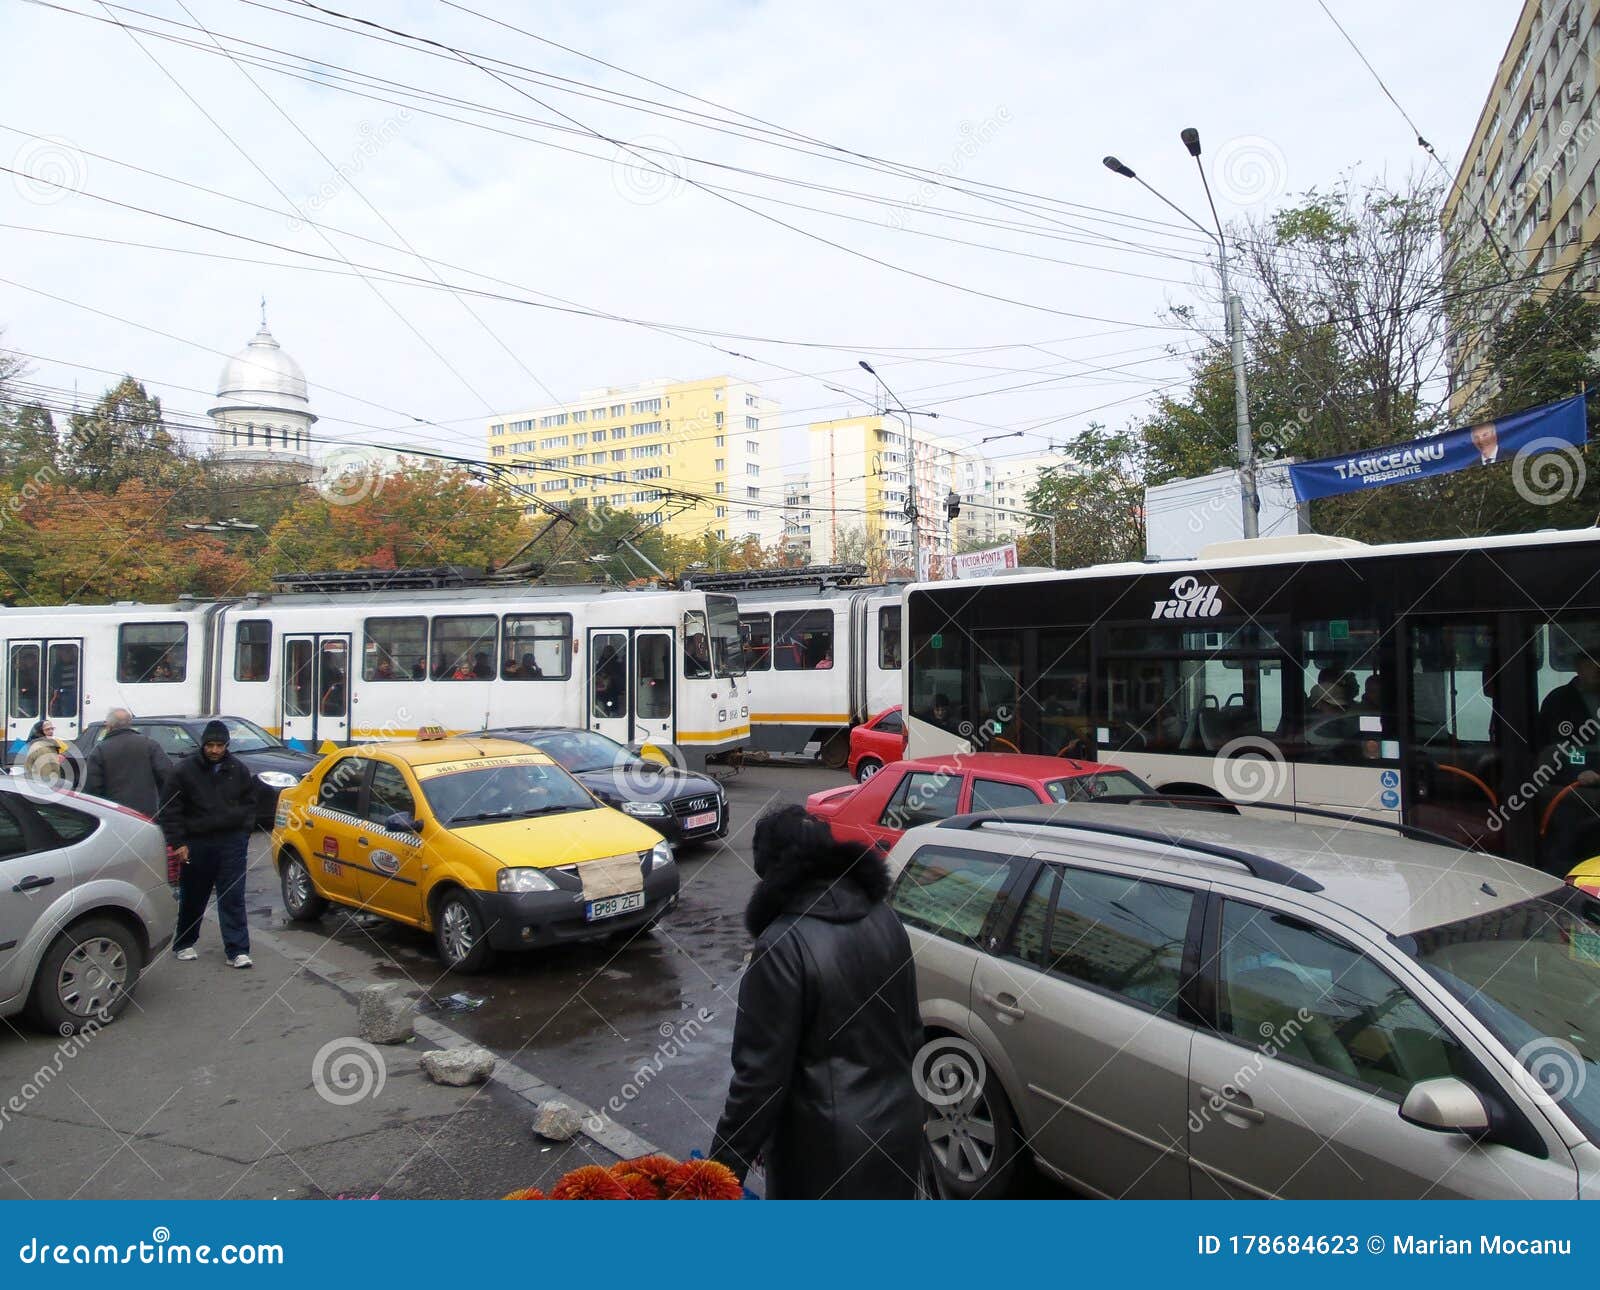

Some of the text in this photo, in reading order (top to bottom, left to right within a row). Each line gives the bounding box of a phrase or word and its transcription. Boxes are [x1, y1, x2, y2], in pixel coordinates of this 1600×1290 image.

[1334, 443, 1444, 479] TĂRICEANU
[962, 556, 979, 568] VICTOR
[981, 551, 1000, 564] PONTA
[604, 899, 617, 914] 89
[621, 894, 641, 909] ZET
